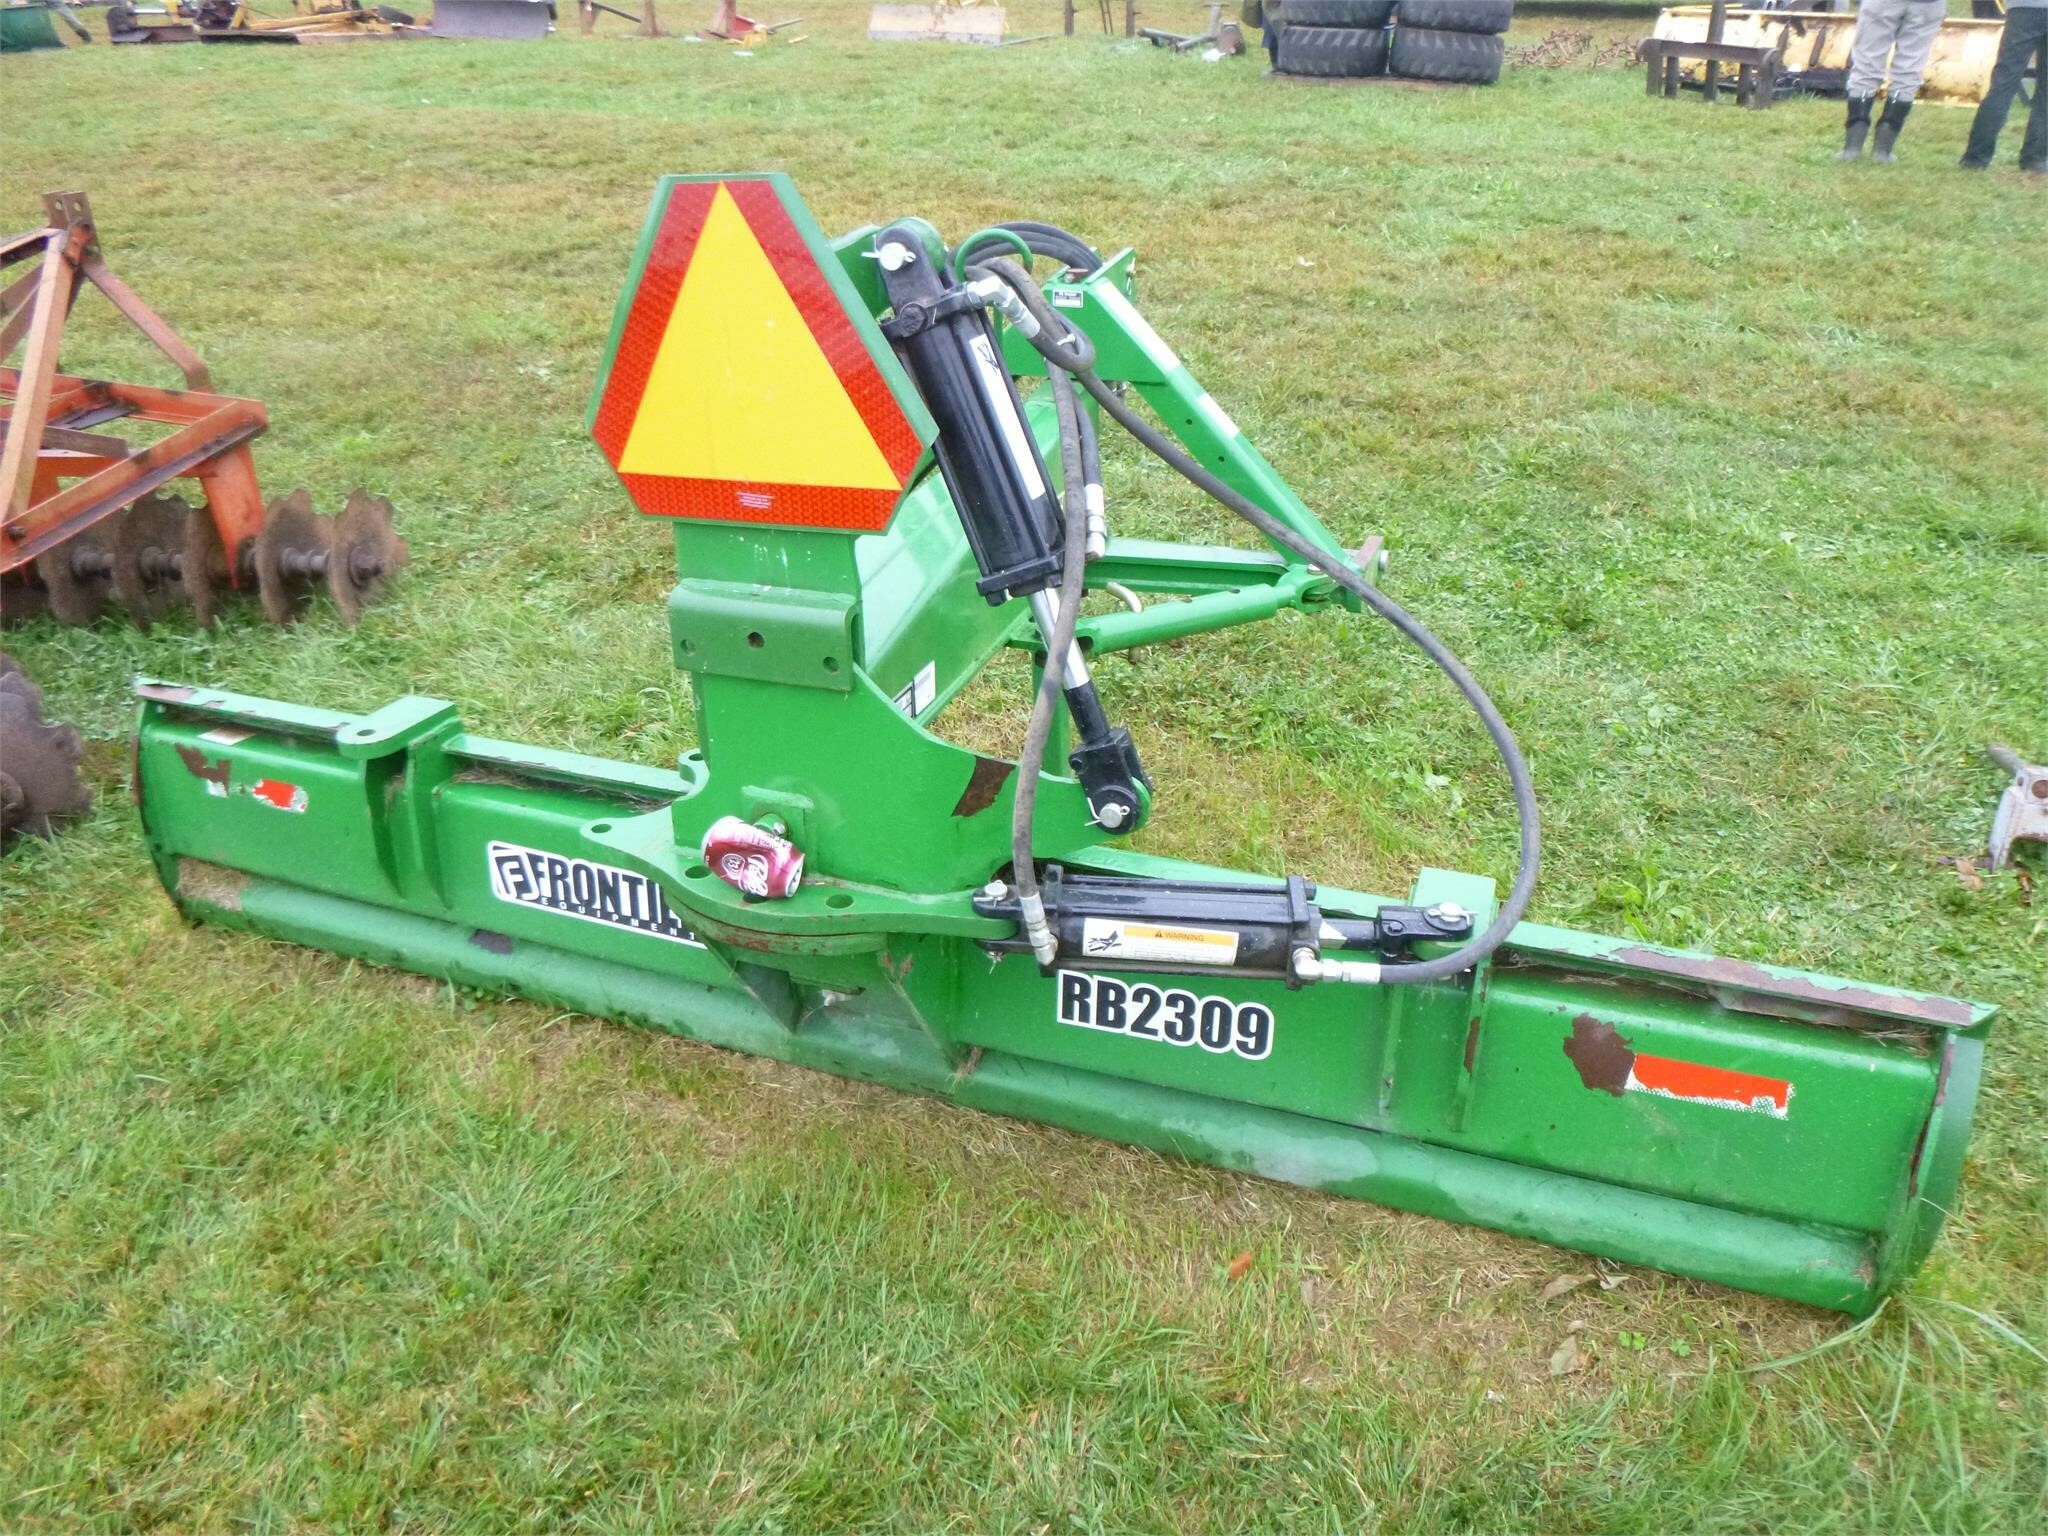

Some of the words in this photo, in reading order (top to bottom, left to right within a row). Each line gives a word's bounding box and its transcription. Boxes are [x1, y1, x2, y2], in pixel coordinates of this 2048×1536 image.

[525, 852, 690, 932] FRONTI
[1165, 931, 1205, 942] WARNING
[1061, 973, 1270, 1057] RB2309
